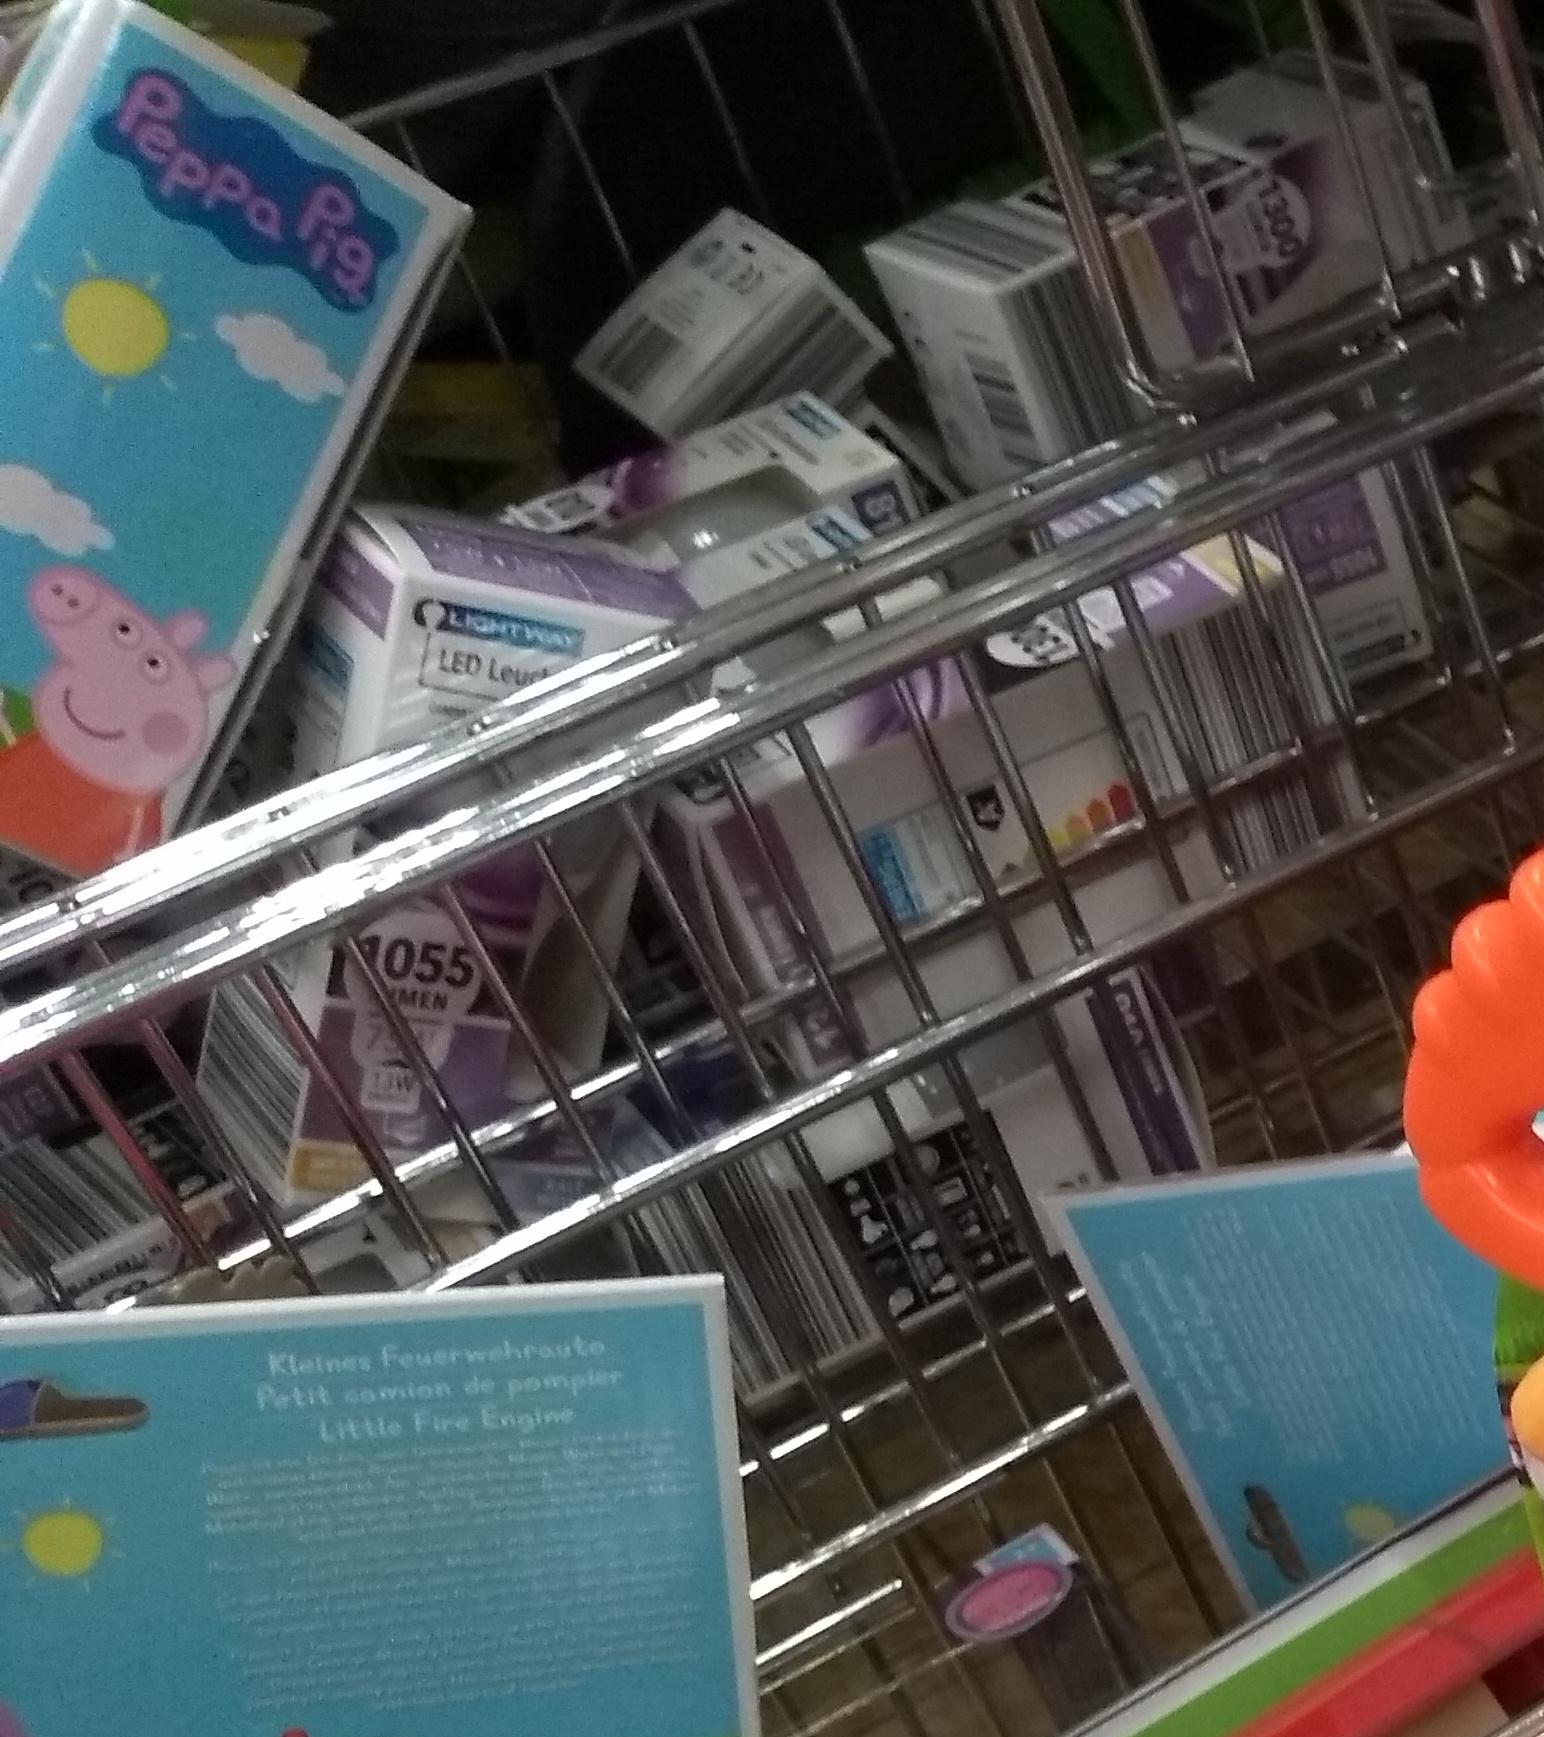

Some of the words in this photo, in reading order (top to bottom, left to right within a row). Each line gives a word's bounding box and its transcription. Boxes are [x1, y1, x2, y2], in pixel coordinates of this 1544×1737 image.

[117, 74, 283, 242] Peppa
[298, 184, 374, 302] Pig
[439, 648, 482, 676] LED
[488, 656, 552, 690] Leuc
[267, 1350, 371, 1377] Kleines
[382, 1335, 605, 1369] Feuerwehrauto
[256, 1380, 330, 1411] Petit
[345, 1382, 451, 1405] camion
[464, 1375, 495, 1396] de
[508, 1367, 622, 1401] pompier
[319, 1414, 402, 1443] Little
[414, 1406, 470, 1434] Fire
[481, 1403, 568, 1435] Engine
